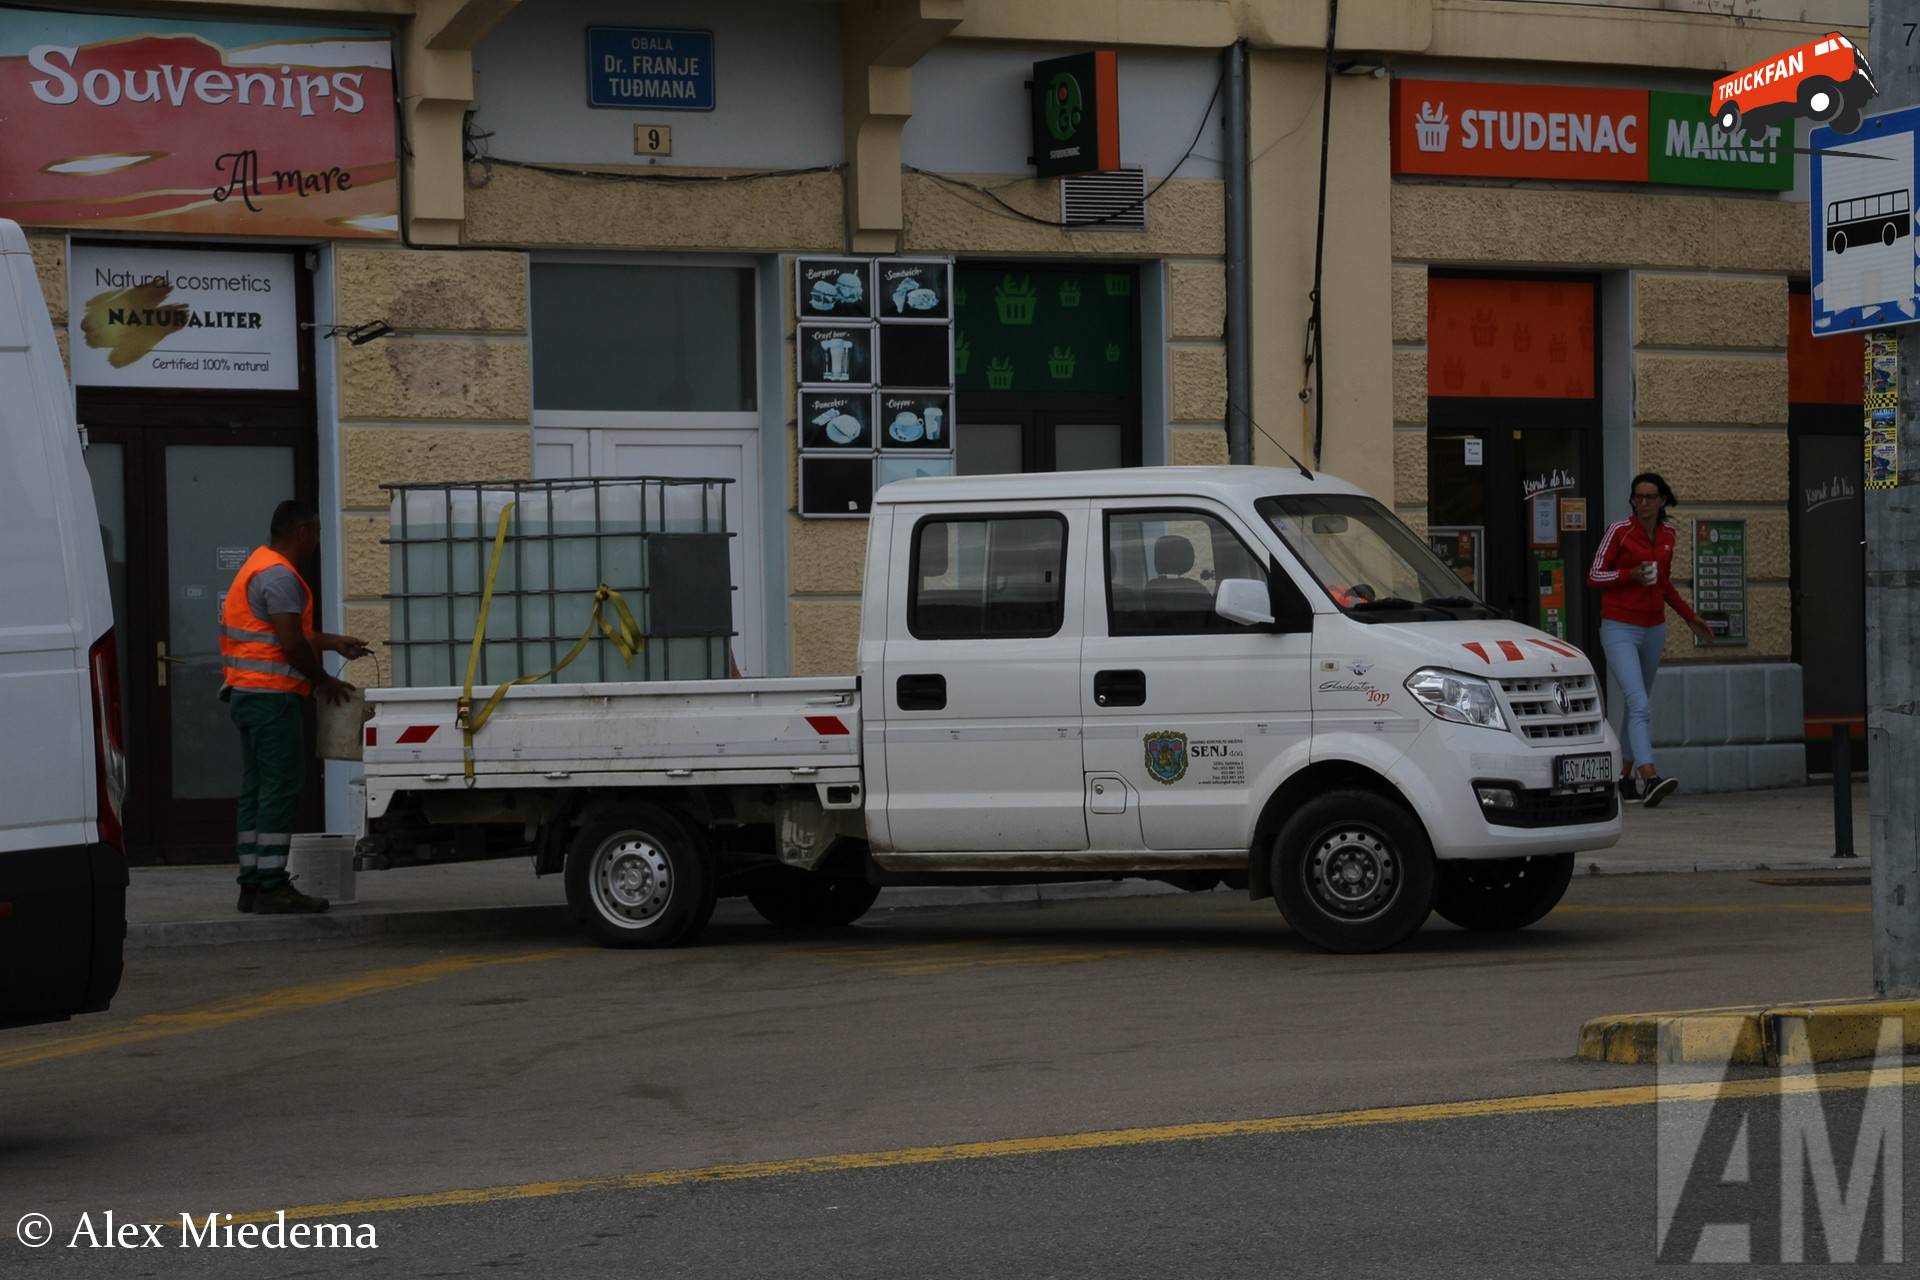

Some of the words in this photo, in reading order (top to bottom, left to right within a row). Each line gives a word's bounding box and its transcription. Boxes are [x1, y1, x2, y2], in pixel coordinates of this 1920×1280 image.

[631, 37, 673, 51] OBALA
[1903, 22, 1917, 46] 7
[604, 54, 627, 74] Dr.
[633, 56, 700, 76] FRANJE
[28, 45, 366, 117] Souvenirs
[608, 78, 697, 99] TUĐMANA
[648, 129, 659, 150] 9
[1460, 109, 1638, 154] STUDENAC
[213, 150, 263, 212] Al
[272, 166, 353, 197] mare
[96, 268, 172, 290] Natural
[176, 272, 272, 292] cosmetics
[108, 307, 262, 330] NATURALITER
[152, 357, 199, 372] Certified
[202, 358, 231, 372] 100%
[233, 358, 270, 373] natural
[1366, 689, 1390, 706] Top
[1190, 745, 1228, 757] SENJ
[1564, 760, 1575, 782] GS
